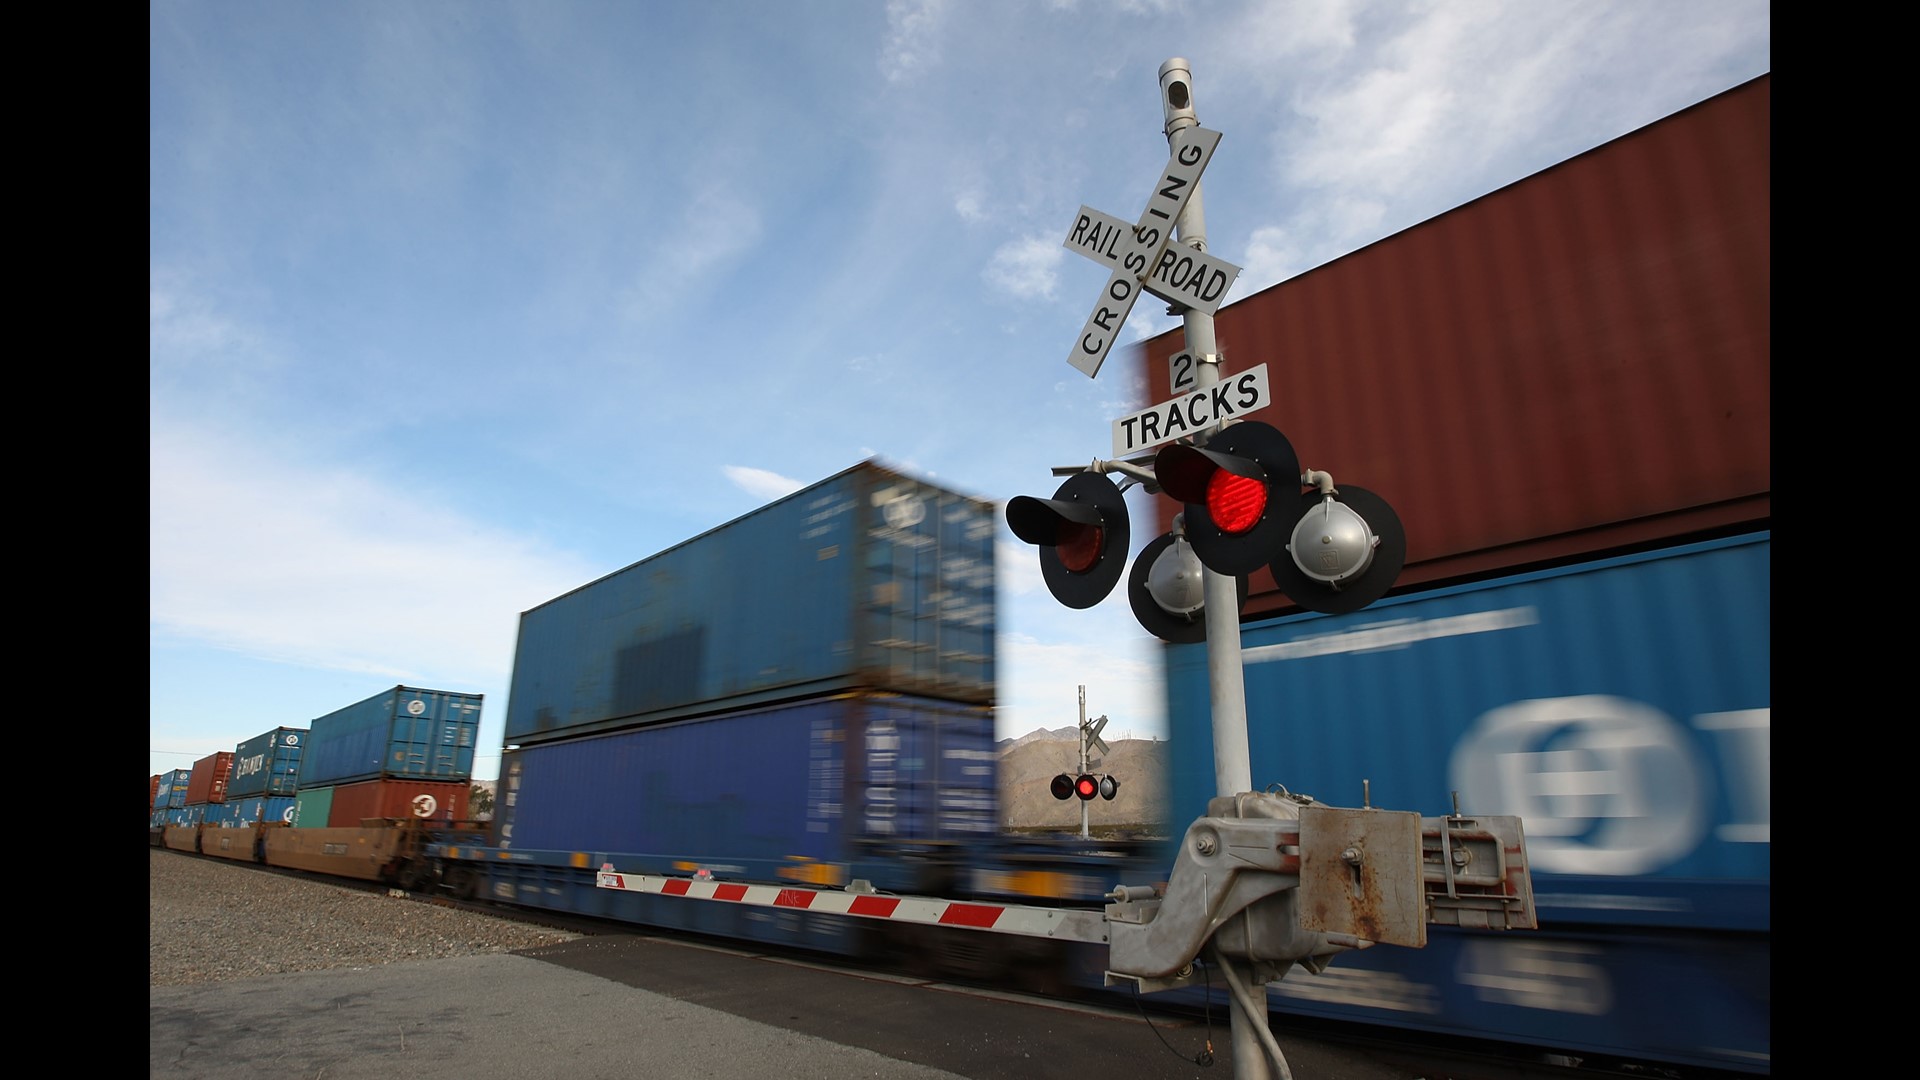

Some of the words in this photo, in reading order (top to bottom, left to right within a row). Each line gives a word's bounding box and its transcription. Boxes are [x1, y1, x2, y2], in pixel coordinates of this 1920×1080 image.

[1071, 215, 1122, 260] RAIL
[1154, 249, 1227, 302] ROAD
[1082, 144, 1202, 355] CROSSING
[1121, 374, 1259, 449] TRACKS
[1173, 356, 1194, 389] 2
